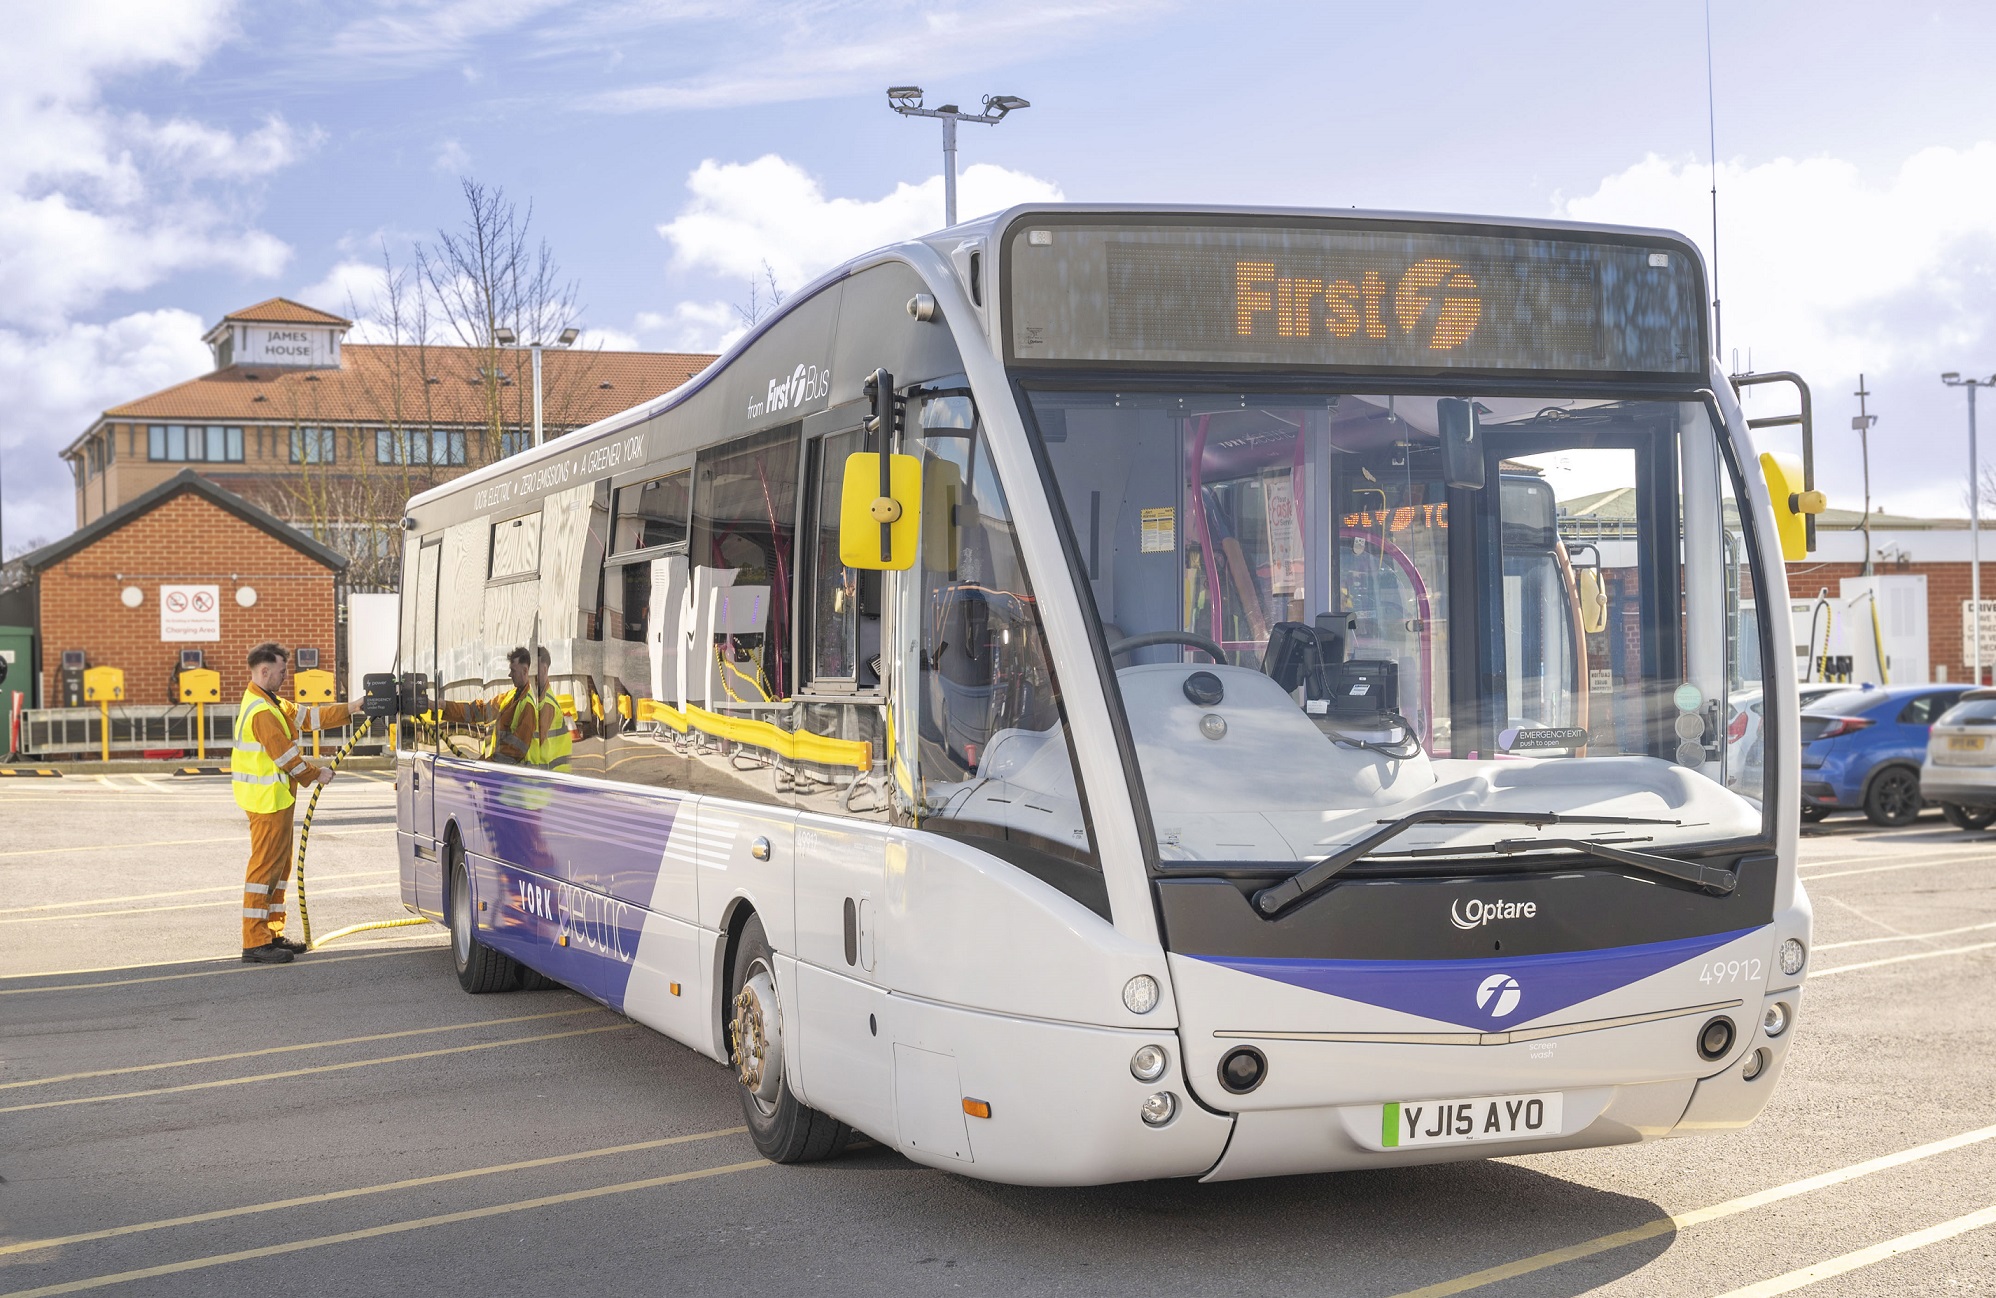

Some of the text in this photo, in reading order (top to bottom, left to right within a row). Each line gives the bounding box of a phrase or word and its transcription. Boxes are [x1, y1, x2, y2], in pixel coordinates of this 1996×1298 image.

[1237, 262, 1386, 338] First
[268, 331, 307, 342] JAMES
[265, 345, 310, 356] HOUSE
[748, 365, 829, 419] from First Bus
[487, 480, 512, 507] ELECTRIC
[520, 473, 536, 496] ZERO
[536, 460, 570, 491] EMISSIONS
[580, 455, 586, 476] A
[588, 442, 621, 474] GREENER
[622, 434, 645, 462] YORK
[165, 626, 198, 635] Charging
[1520, 730, 1566, 739] EMERGENCY
[518, 860, 630, 963] YORK electric
[1465, 899, 1537, 926] Optare
[1699, 958, 1761, 985] 49912
[1529, 1042, 1557, 1051] screen
[1530, 1049, 1554, 1059] wash
[1404, 1099, 1544, 1139] YJ15 AYO
